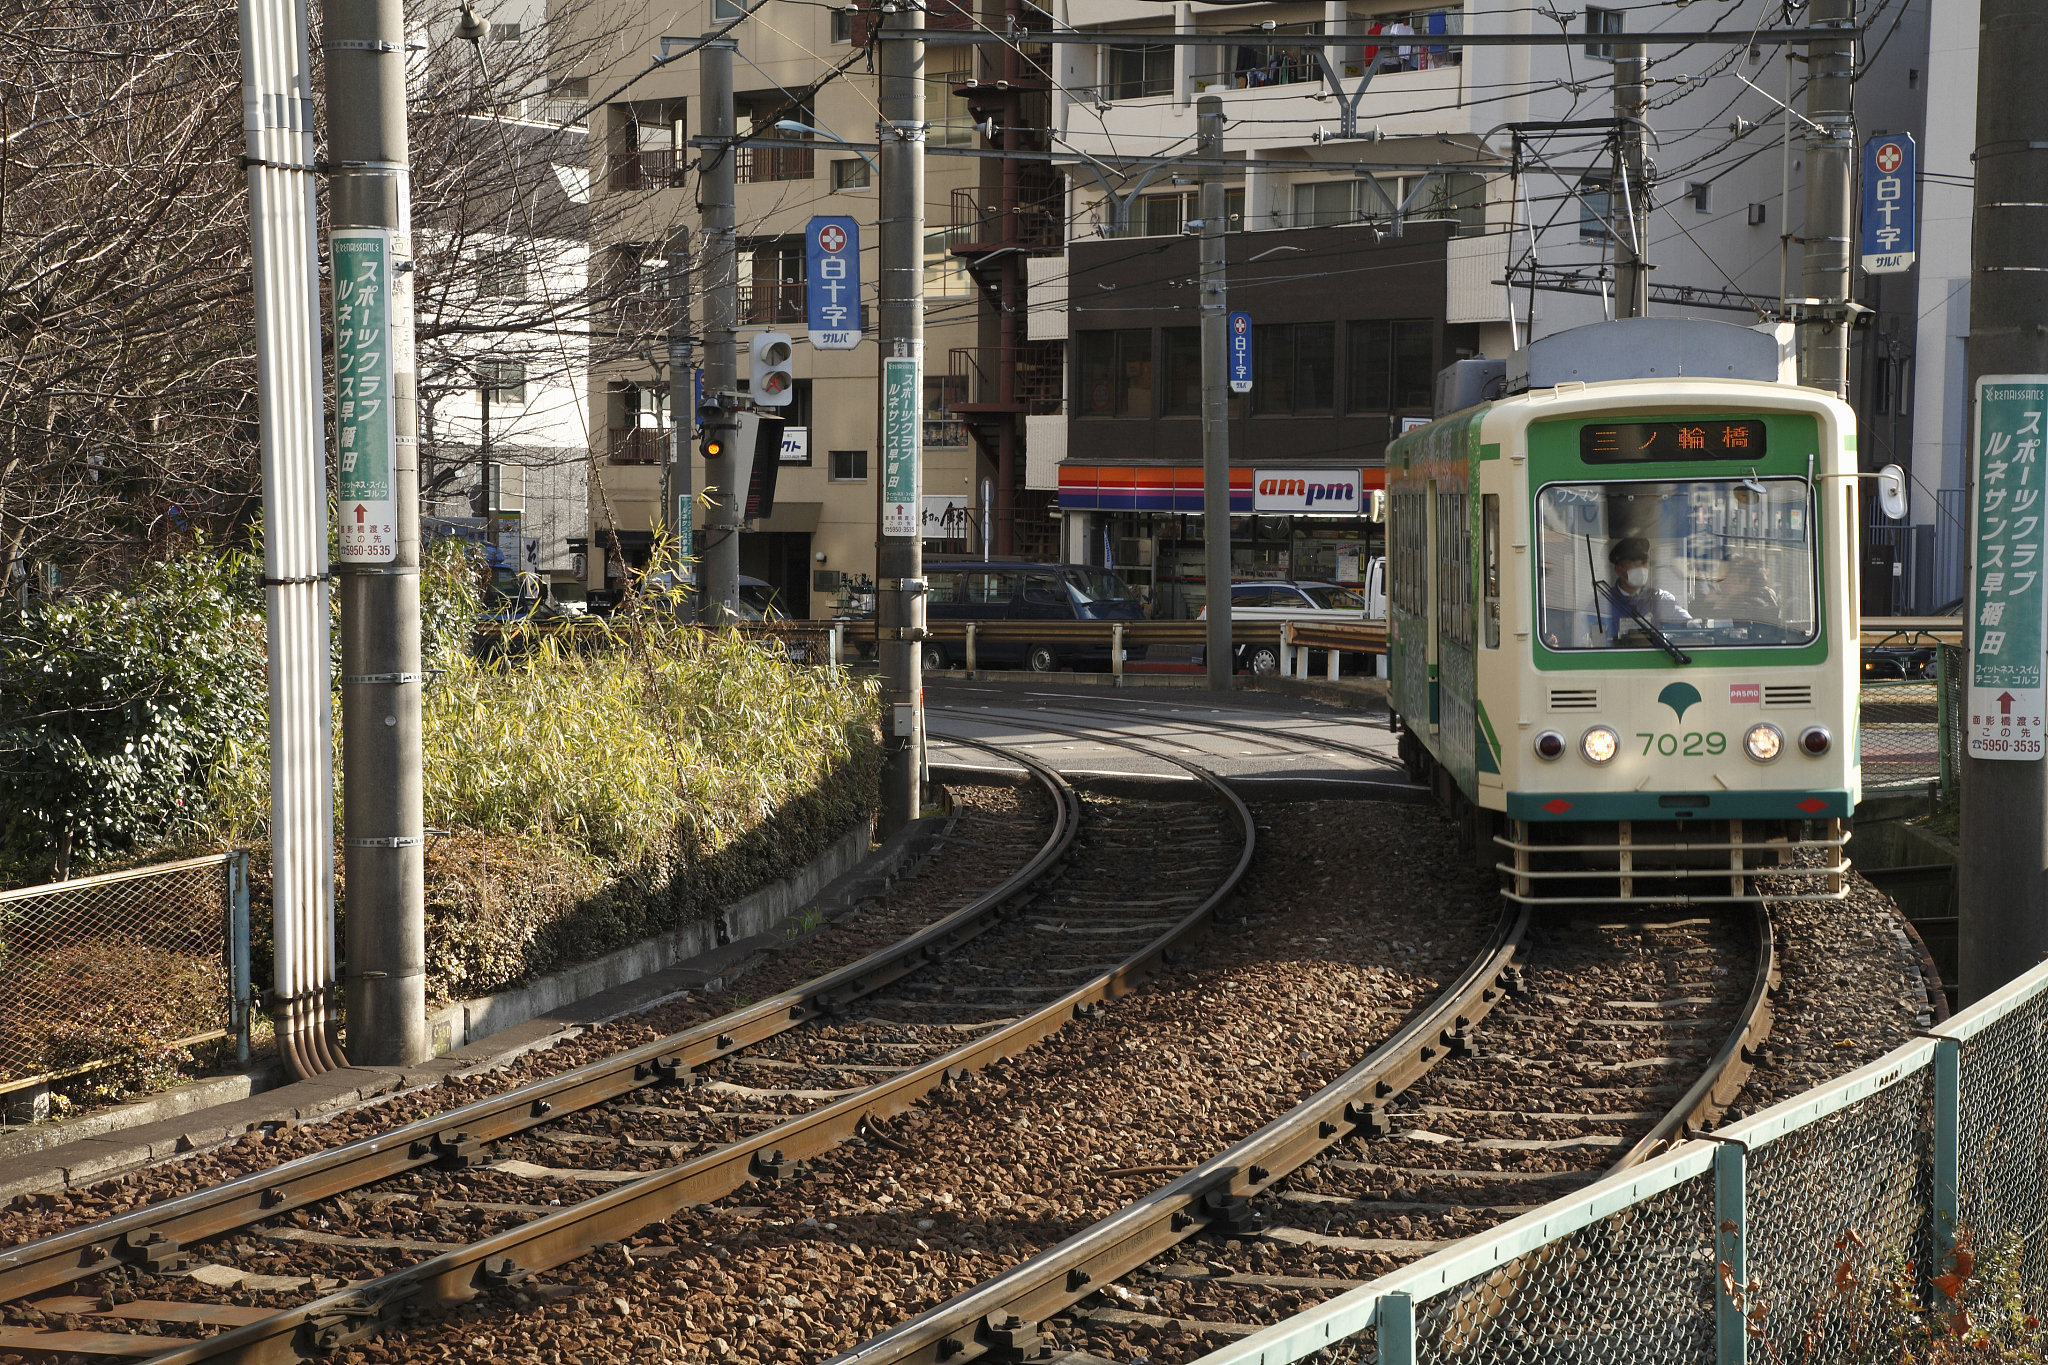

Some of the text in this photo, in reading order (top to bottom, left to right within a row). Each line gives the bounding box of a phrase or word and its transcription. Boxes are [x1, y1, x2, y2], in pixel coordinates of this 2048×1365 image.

[1876, 175, 1901, 250] 白十字
[1876, 255, 1902, 268] サルバ
[821, 255, 848, 328] 白十字
[354, 261, 382, 421] スポーツクラブ
[822, 332, 850, 344] サルバ
[1235, 335, 1247, 379] 白十字
[336, 279, 359, 473] ルネサンス早稲田
[1994, 389, 2044, 401] RENAISSANCE
[900, 374, 914, 461] スポーツクラブ
[888, 383, 900, 488] ルネサンス早稲田
[1593, 426, 1750, 451] 三ノ輪橋
[1556, 488, 1600, 504] ワンマン
[2008, 411, 2042, 596] スポーツクラブ
[345, 545, 391, 556] 5950-3535
[1979, 431, 2012, 656] ルネサンス早稲田
[1975, 664, 2040, 675] フィットネス・スイム
[1975, 674, 2040, 685] テニス・ゴルフ
[1730, 690, 1759, 698] PASMO
[1972, 715, 2041, 727] 面影橋渡る
[1982, 727, 2031, 738] この先
[1636, 732, 1727, 756] 7029
[1982, 739, 2041, 753] 5950-3535
